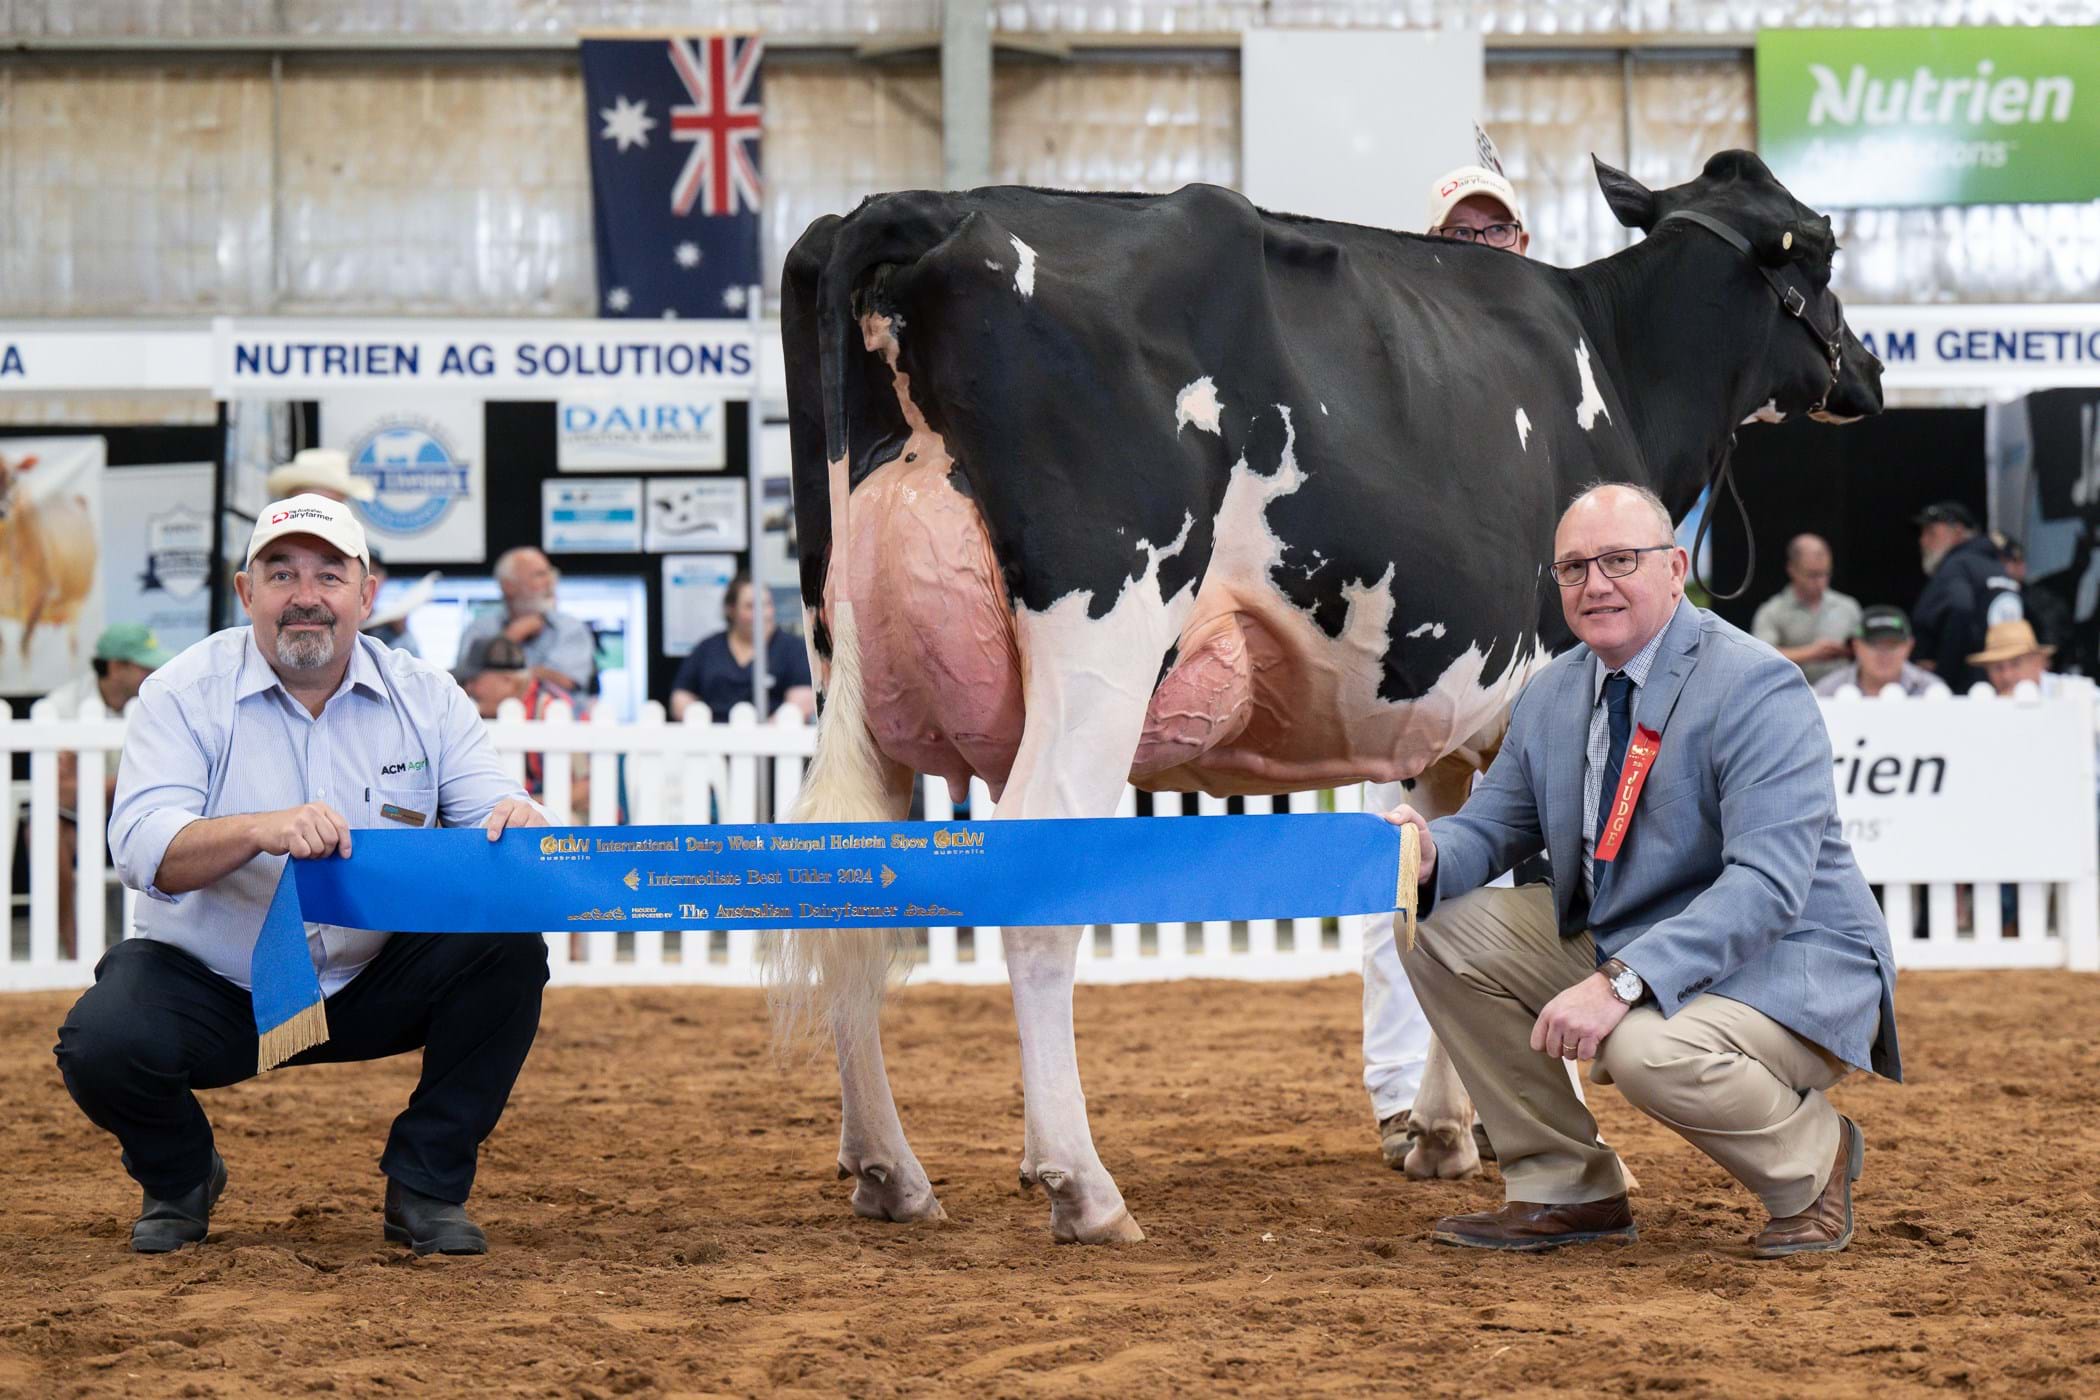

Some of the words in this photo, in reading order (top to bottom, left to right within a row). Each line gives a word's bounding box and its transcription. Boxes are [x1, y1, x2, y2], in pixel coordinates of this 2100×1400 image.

[1808, 59, 2075, 126] Nutrien
[1, 345, 25, 375] A
[235, 344, 419, 375] NUTRIEN
[440, 344, 496, 375] AG
[516, 343, 752, 376] SOLUTIONS
[564, 405, 712, 431] DAIRY
[381, 763, 406, 775] ACM
[1606, 771, 1639, 846] JUDGE
[596, 837, 679, 852] International
[685, 836, 724, 854] Dairy
[728, 835, 765, 850] Week
[770, 836, 826, 852] National
[830, 835, 886, 849] Holstein
[890, 834, 928, 850] Show
[647, 869, 742, 887] Intermediate
[747, 869, 783, 885] Best
[788, 869, 832, 884] Udder
[838, 868, 873, 884] 2024
[679, 904, 709, 919] The
[714, 903, 793, 919] Australian
[798, 903, 899, 922] Dairyfarmer
